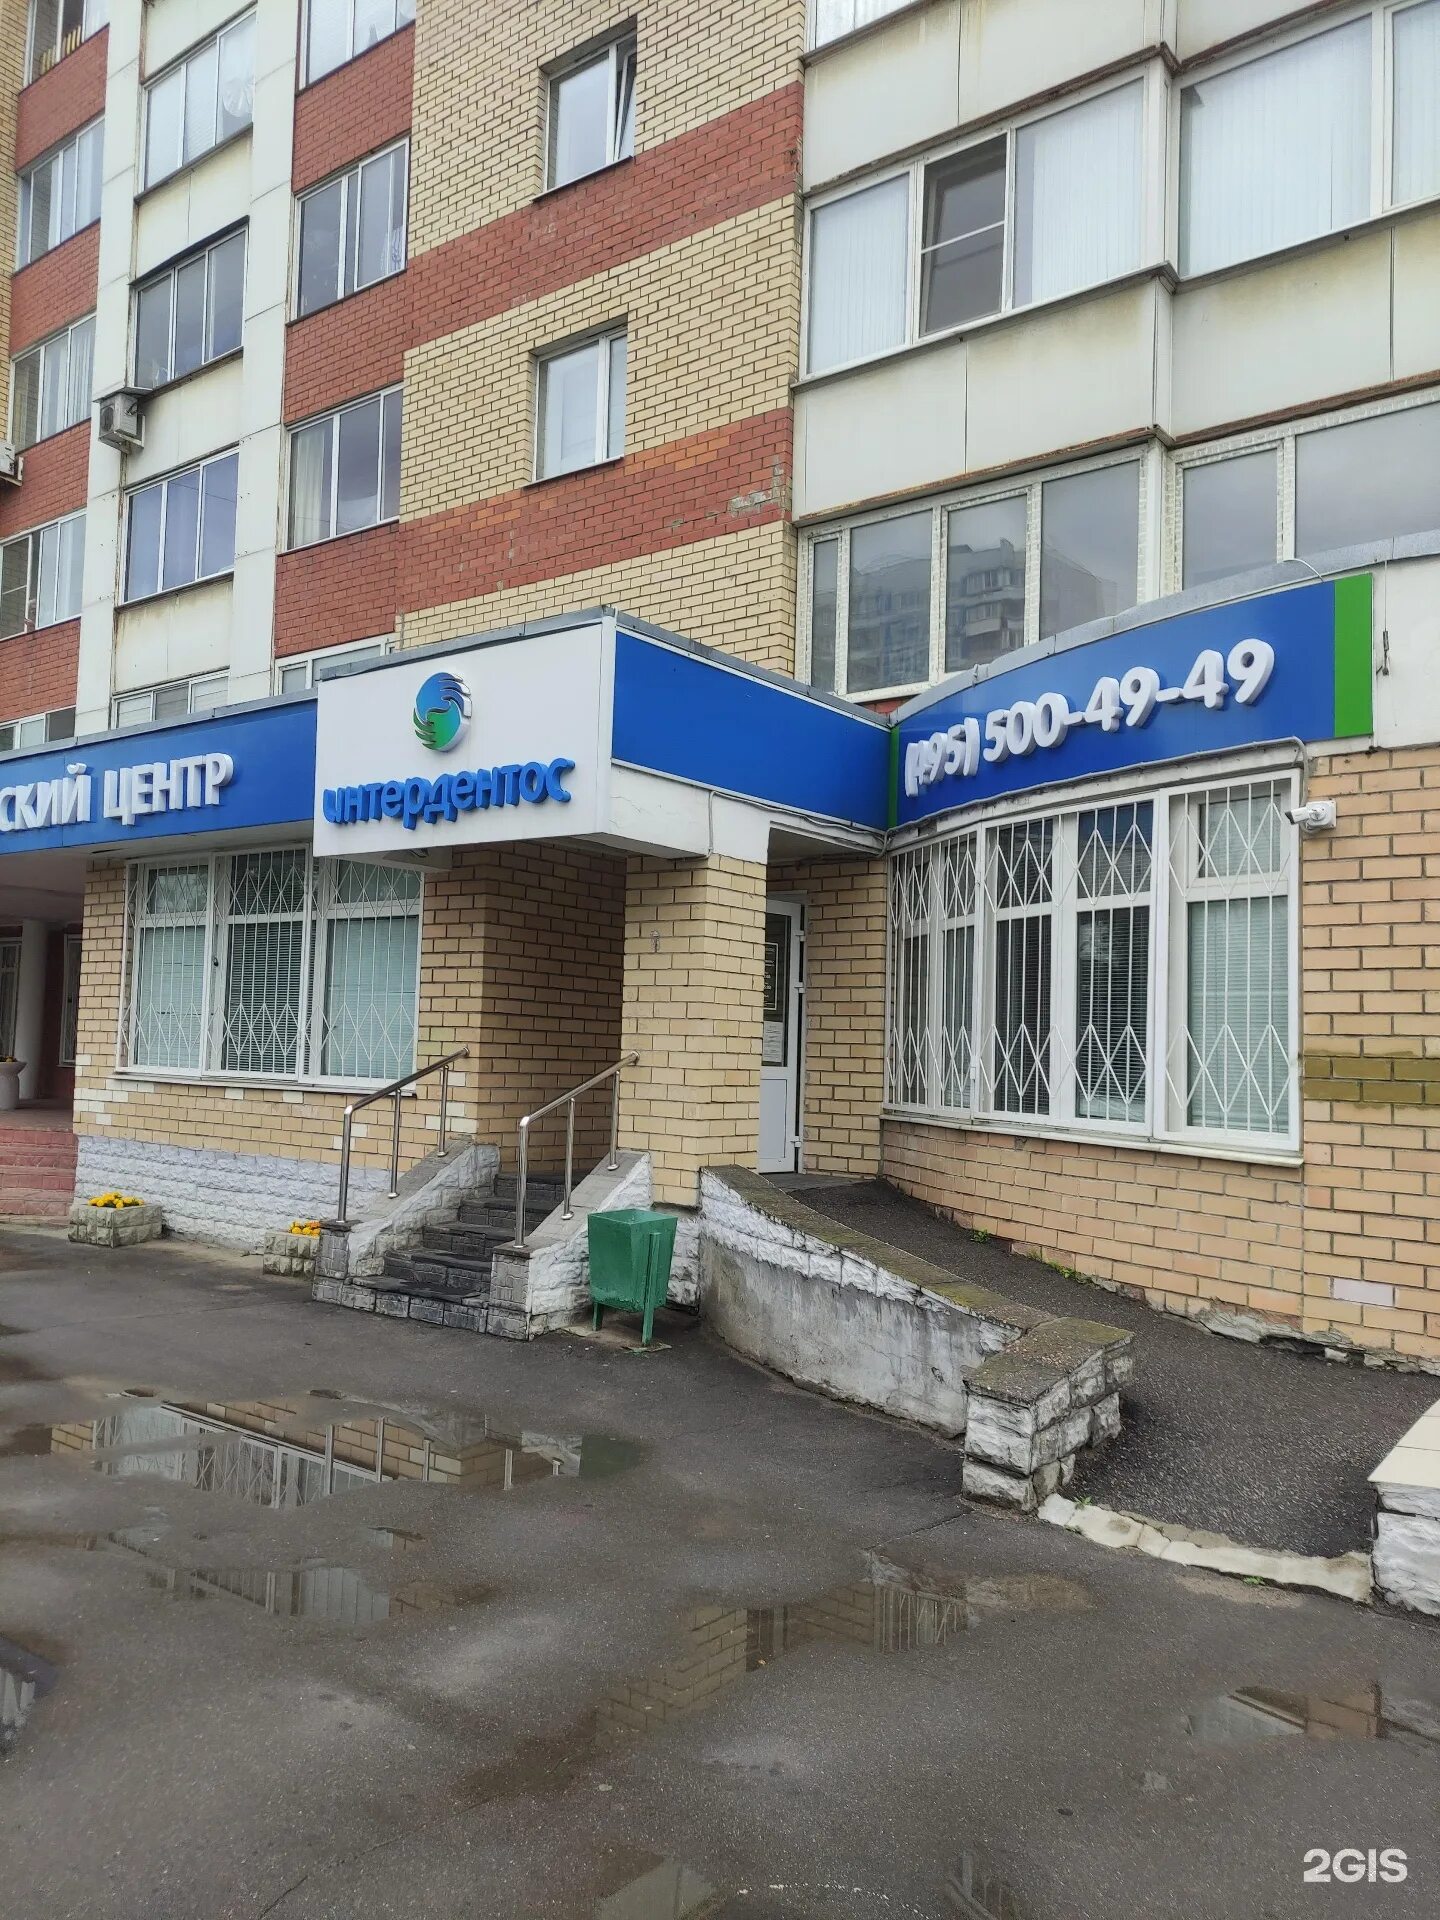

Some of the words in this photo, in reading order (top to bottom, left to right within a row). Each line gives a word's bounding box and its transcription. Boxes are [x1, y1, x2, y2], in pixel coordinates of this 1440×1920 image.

[904, 717, 980, 797] (495)
[982, 638, 1275, 761] 500-49-49
[0, 762, 92, 832] СКИЙ
[103, 752, 234, 826] ЦЕНТР
[322, 757, 576, 831] интердентос
